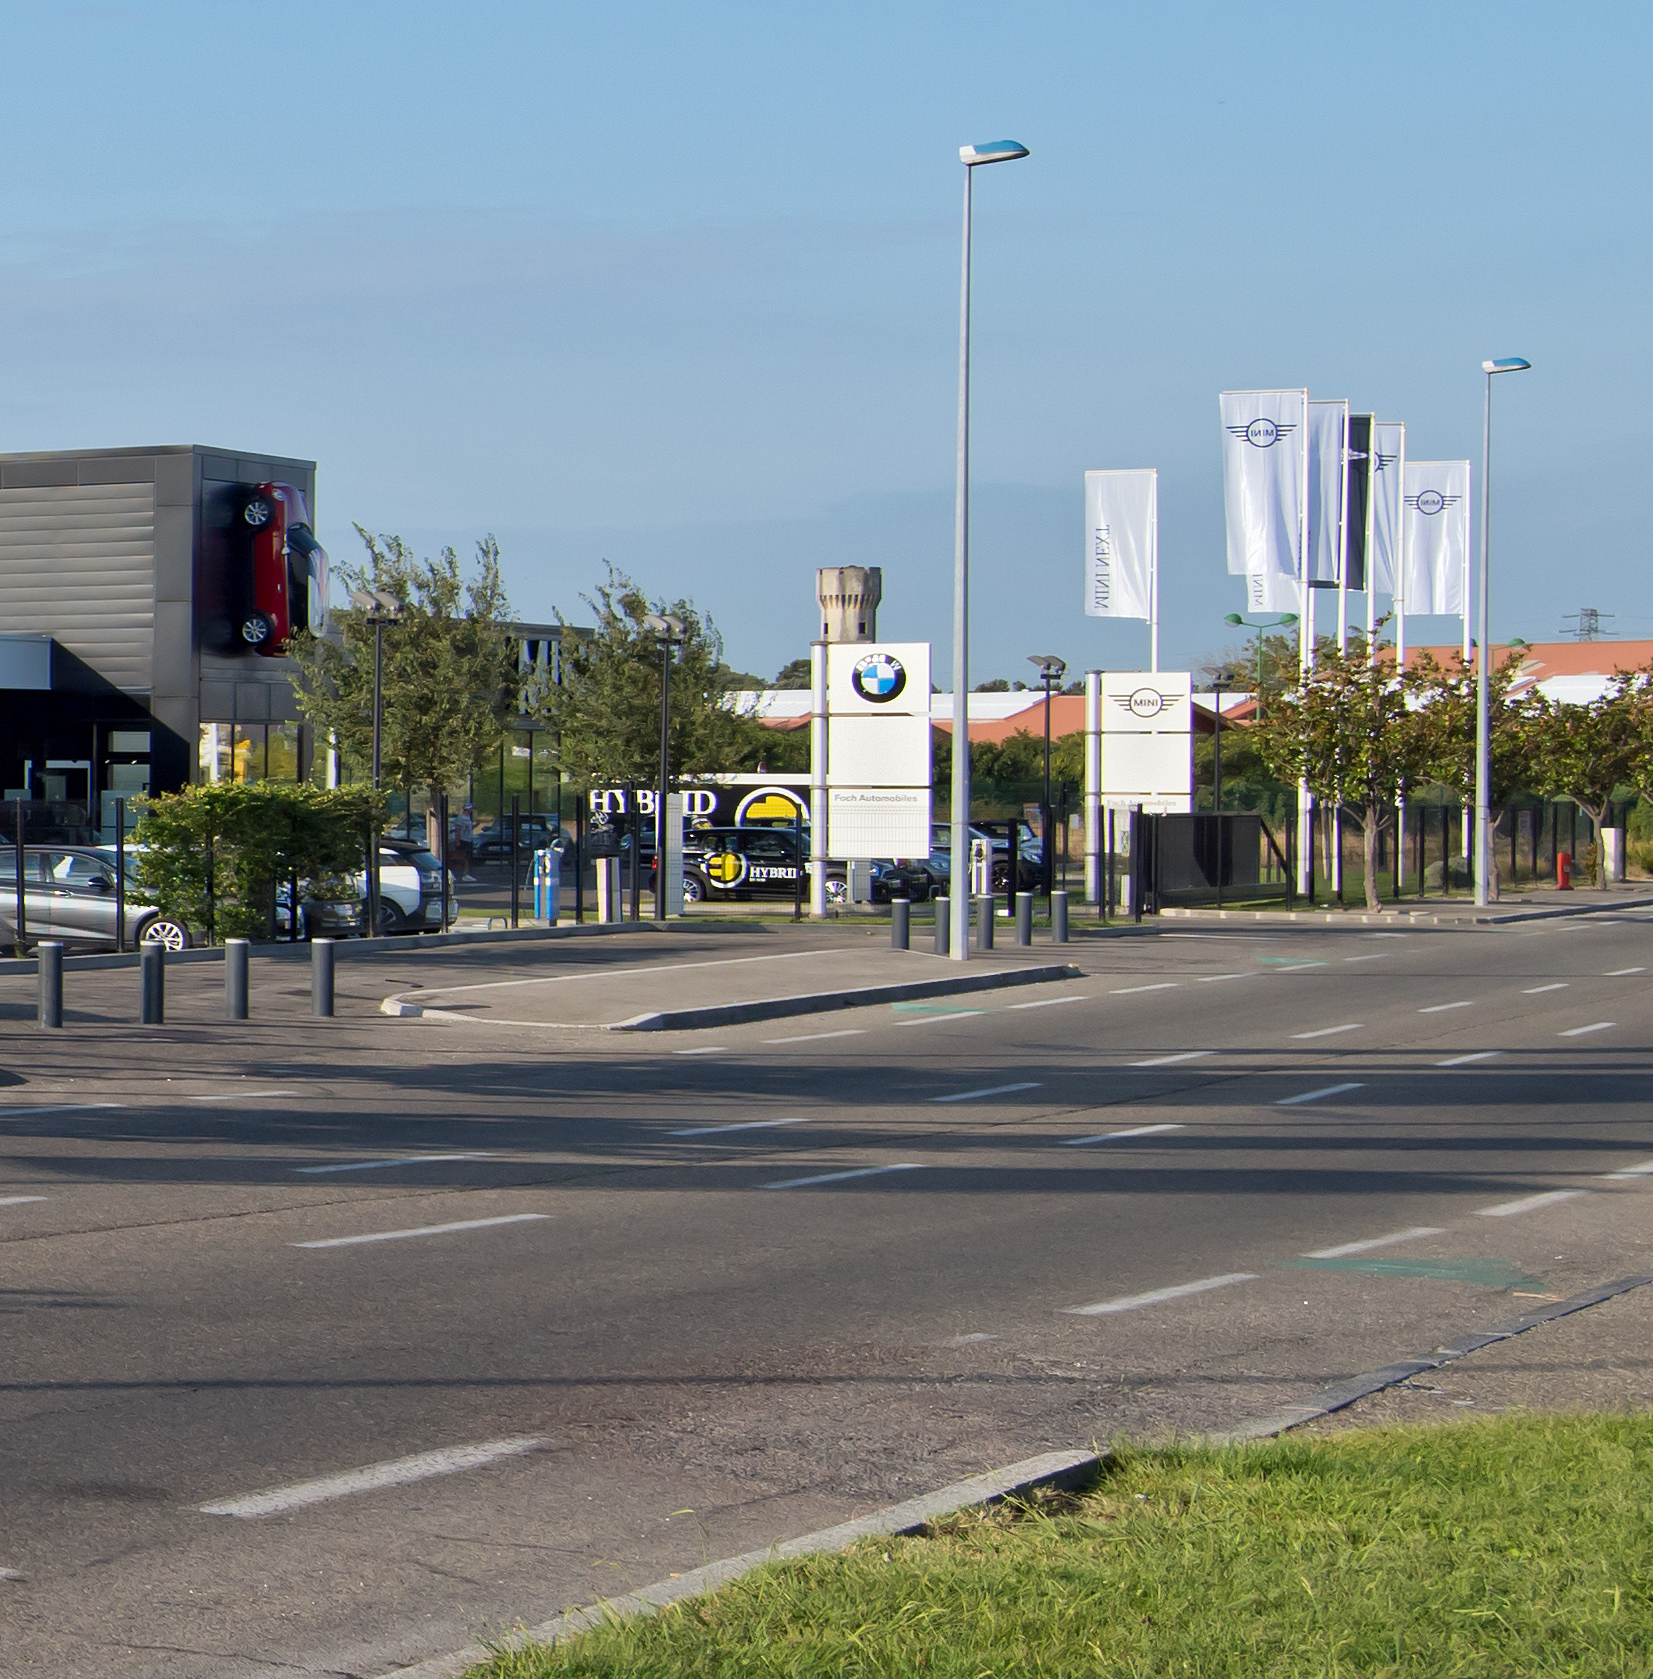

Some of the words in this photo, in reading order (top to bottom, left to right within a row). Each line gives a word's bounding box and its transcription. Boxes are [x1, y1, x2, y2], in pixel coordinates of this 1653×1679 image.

[1134, 699, 1158, 707] MINI
[589, 789, 717, 814] HYBID
[834, 794, 857, 802] Foch
[858, 794, 918, 802] Automobiles
